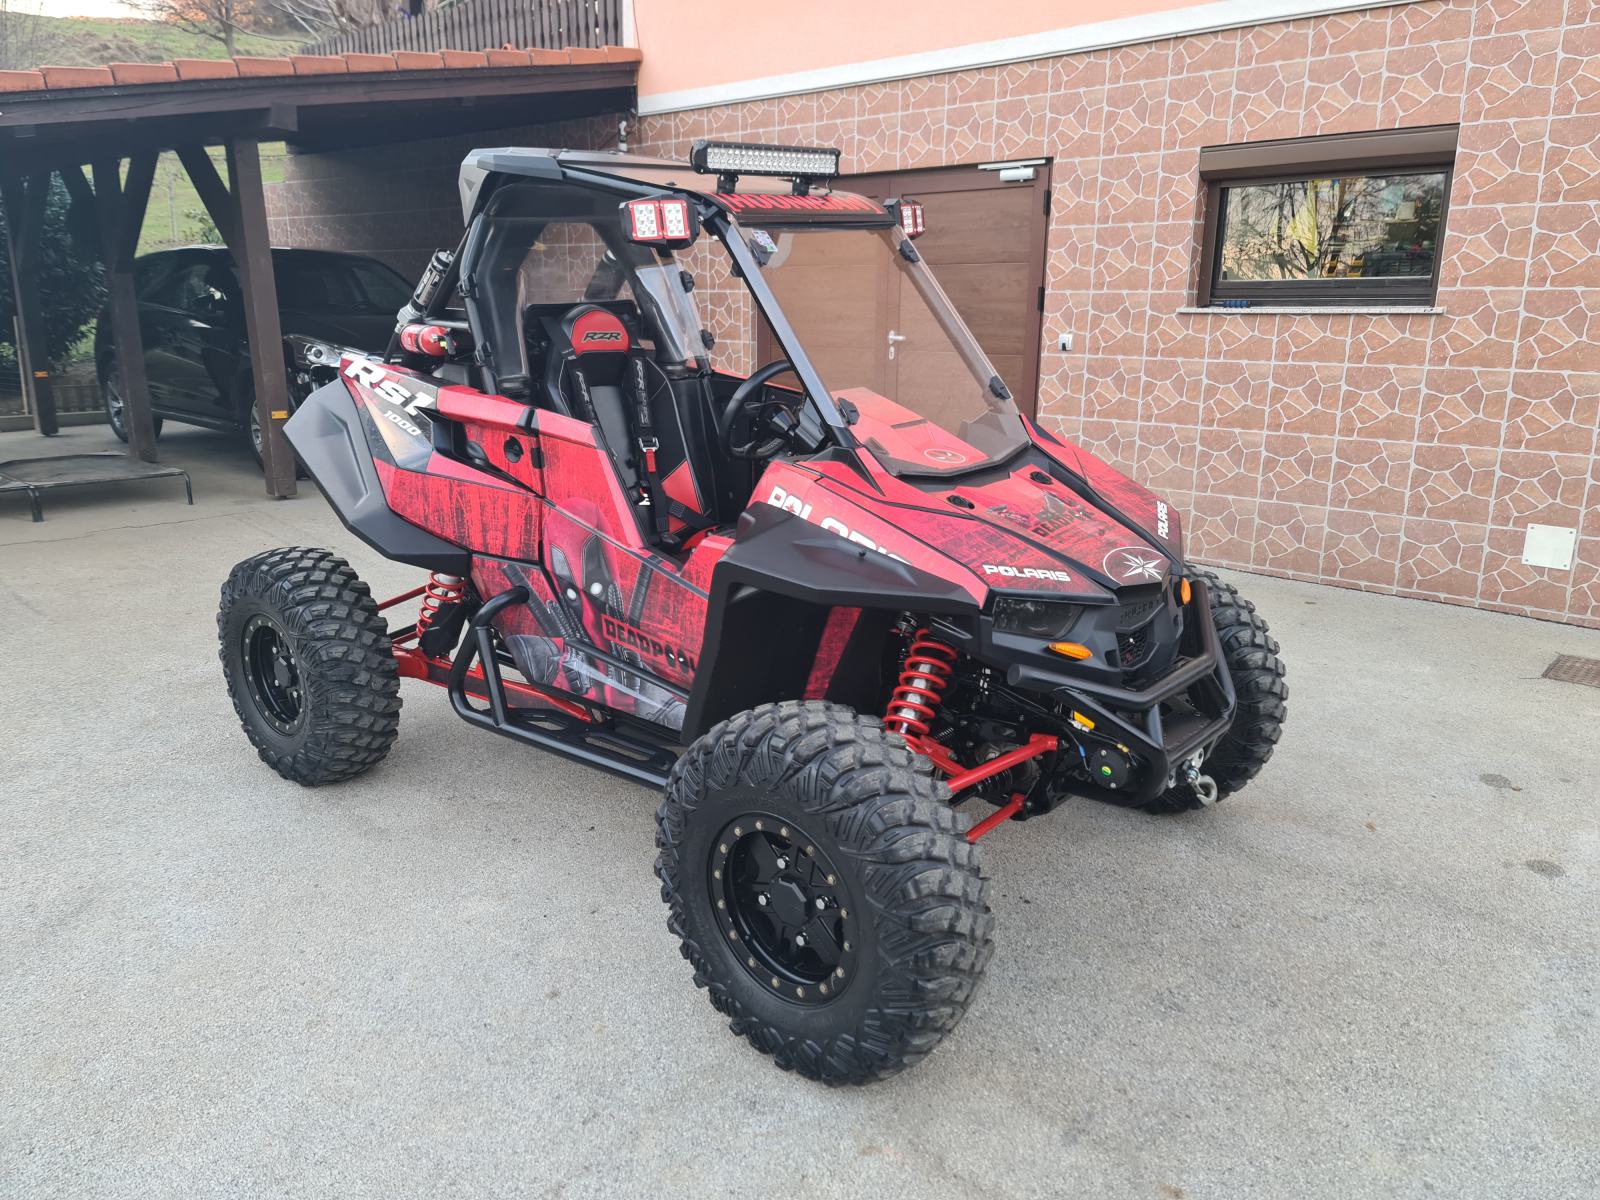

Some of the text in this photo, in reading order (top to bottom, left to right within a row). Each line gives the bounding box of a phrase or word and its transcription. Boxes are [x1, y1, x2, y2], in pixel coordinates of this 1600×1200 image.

[582, 332, 621, 342] RZR
[344, 359, 435, 416] RS1
[384, 410, 421, 437] 1000
[1156, 500, 1169, 540] POLARIS
[982, 564, 1071, 582] POLARIS
